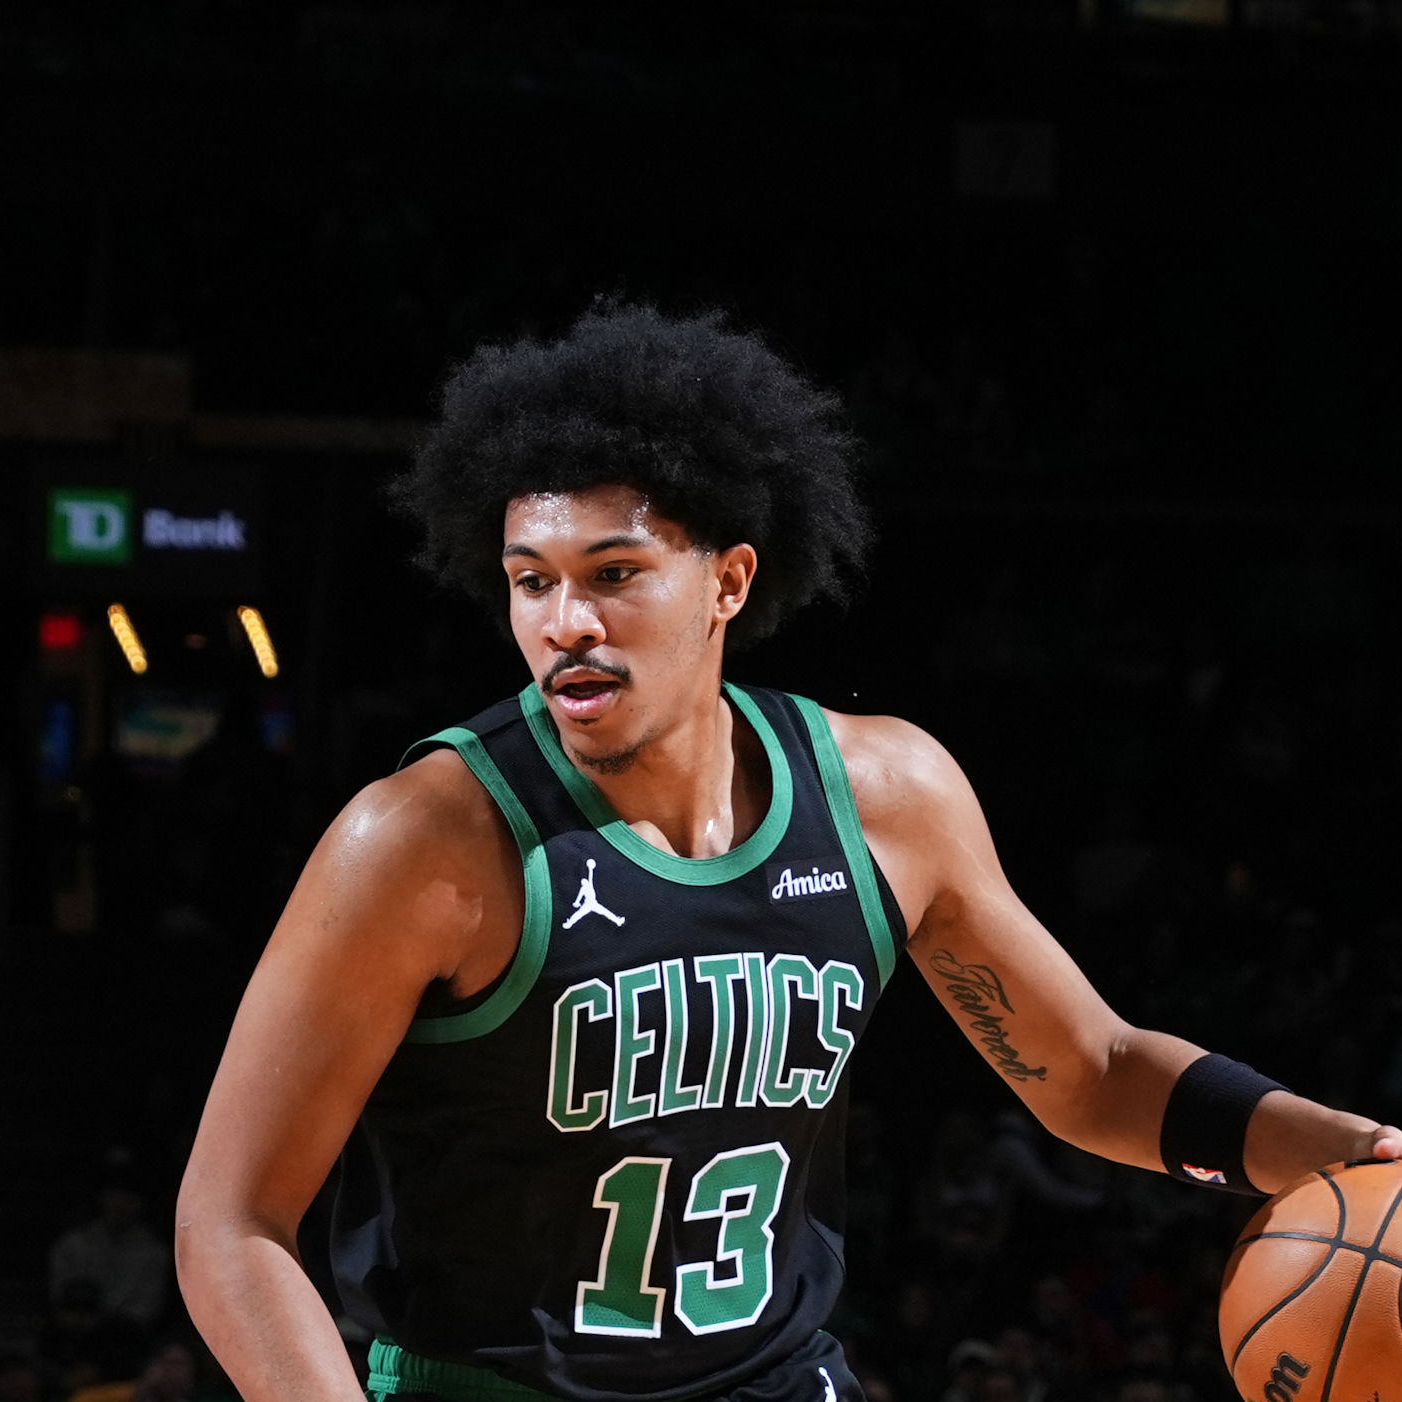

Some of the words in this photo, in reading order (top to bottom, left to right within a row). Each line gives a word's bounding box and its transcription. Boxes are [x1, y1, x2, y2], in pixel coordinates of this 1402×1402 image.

[55, 501, 125, 549] TD
[143, 508, 246, 549] Bank
[771, 866, 848, 900] Amica
[546, 951, 865, 1133] CELTICS
[574, 1140, 791, 1339] 13
